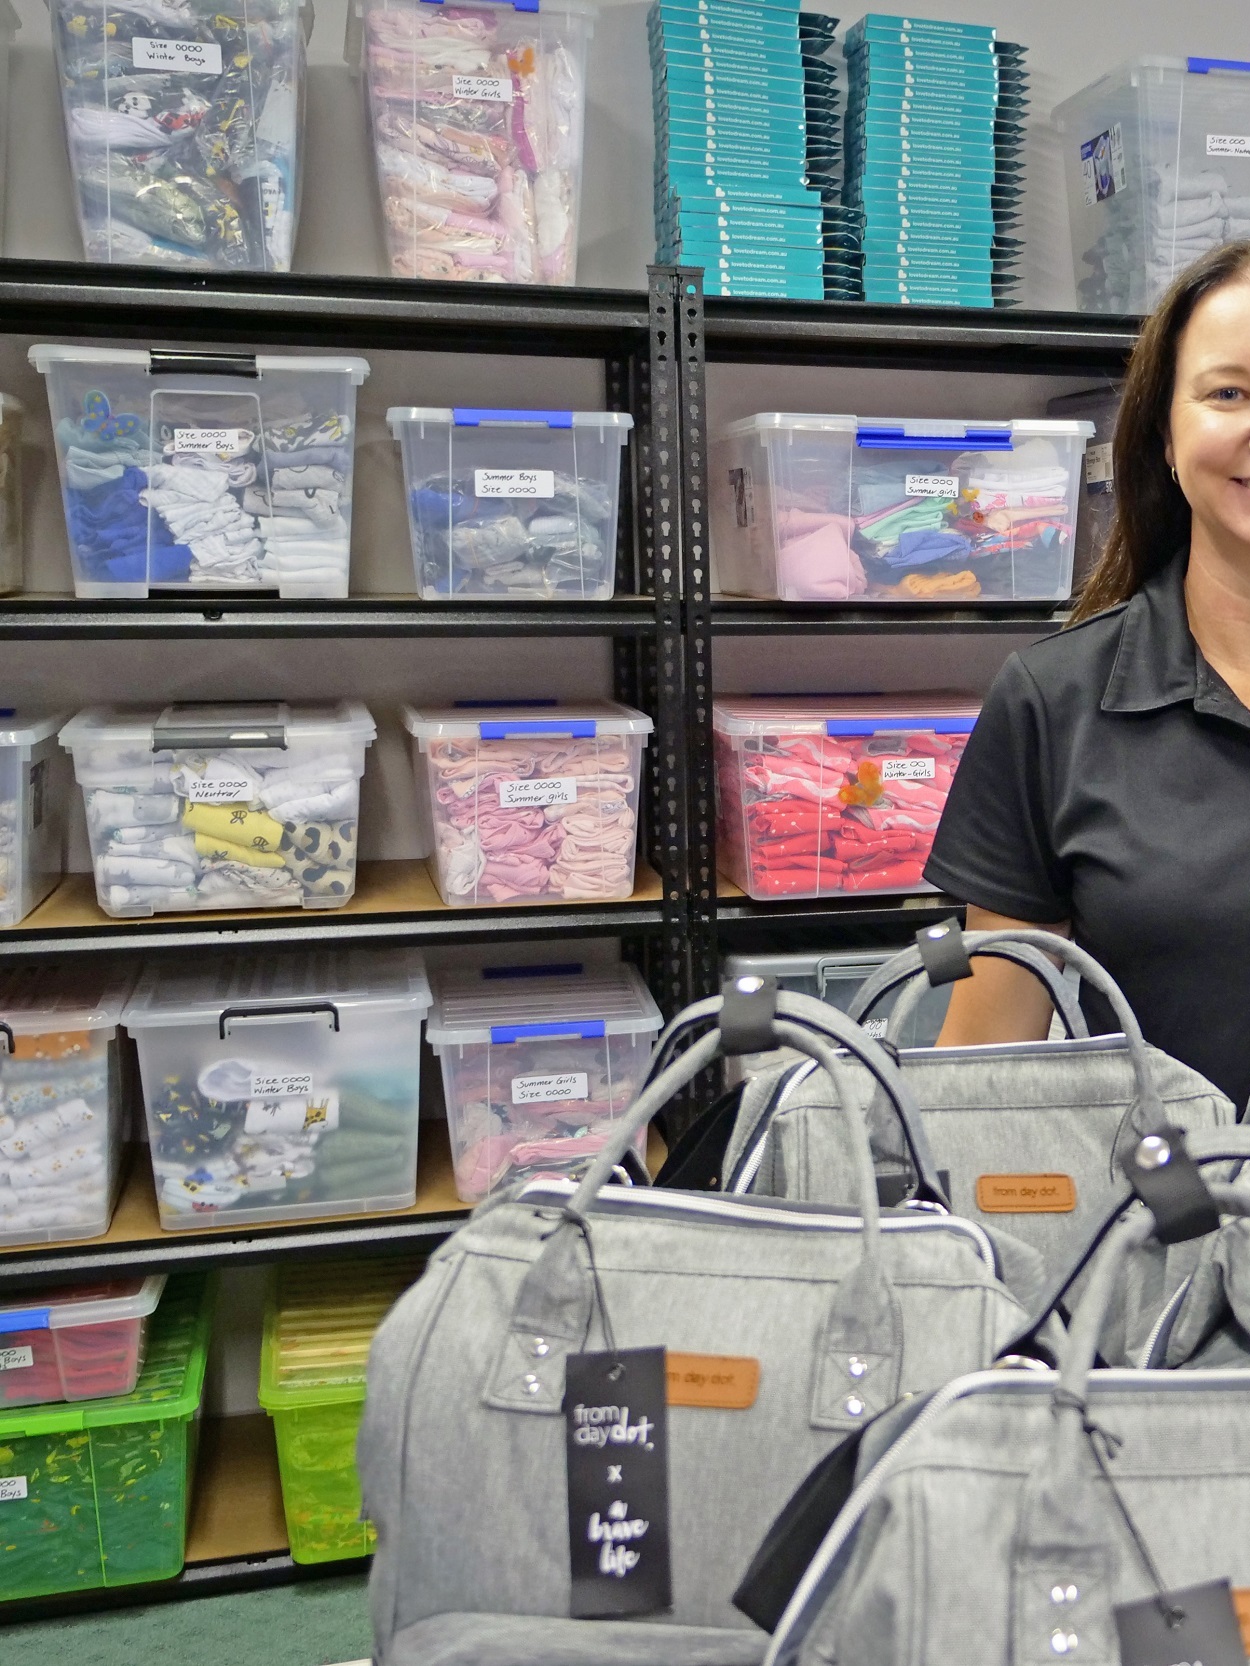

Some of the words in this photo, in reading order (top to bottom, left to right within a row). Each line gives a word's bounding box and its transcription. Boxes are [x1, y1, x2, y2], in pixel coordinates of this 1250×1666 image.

[711, 4, 762, 16] lovetodream.com.au
[711, 19, 763, 31] lovetodream.com.au
[914, 23, 963, 33] lovetodream.com.au
[712, 34, 764, 45] lovetodream.com.au
[912, 37, 960, 47] lovetodream.com.au
[149, 41, 168, 49] Size
[175, 43, 202, 53] 0000
[714, 47, 766, 58] lovetodream.com.au
[916, 51, 964, 60] lovetodream.com.au
[146, 51, 175, 61] Winter
[184, 54, 206, 67] Boys
[716, 61, 768, 73] lovetodream.com.au
[916, 64, 964, 74] lovetodream.com.au
[455, 77, 471, 85] Size
[476, 79, 500, 87] 0000
[716, 76, 768, 87] lovetodream.com.au
[917, 78, 965, 87] lovetodream.com.au
[455, 87, 480, 95] Winter
[481, 88, 501, 98] Girls
[717, 89, 768, 99] lovetodream.com.au
[916, 91, 964, 100] lovetodream.com.au
[717, 102, 769, 113] lovetodream.com.au
[913, 104, 961, 112] lovetodream.com.au
[718, 116, 770, 127] lovetodream.com.au
[912, 117, 960, 126] lovetodream.com.au
[718, 129, 770, 140] lovetodream.com.au
[911, 130, 959, 138] lovetodream.com.au
[719, 143, 770, 153] lovetodream.com.au
[913, 144, 961, 152] lovetodream.com.au
[717, 156, 769, 166] lovetodream.com.au
[913, 156, 961, 165] lovetodream.com.au
[717, 170, 769, 179] lovetodream.com.au
[913, 170, 961, 178] lovetodream.com.au
[909, 183, 957, 191] lovetodream.com.au
[728, 190, 782, 199] lovetodream.com.au
[909, 196, 957, 204] lovetodream.com.au
[733, 205, 786, 214] lovetodream.com.au
[911, 209, 959, 217] lovetodream.com.au
[730, 220, 784, 229] lovetodream.com.au
[732, 234, 785, 242] lovetodream.com.au
[734, 248, 787, 257] lovetodream.com.au
[732, 262, 785, 270] lovetodream.com.au
[733, 275, 786, 284] lovetodream.com.au
[177, 430, 198, 440] Size
[177, 441, 212, 450] Summer
[215, 440, 235, 450] Boys
[482, 472, 514, 481] Summer
[519, 472, 537, 482] Boys
[909, 476, 929, 484] Size
[931, 478, 954, 486] 000
[481, 484, 502, 494] Size
[508, 486, 537, 494] 0000
[907, 486, 936, 494] Summer
[938, 488, 957, 497] girls
[886, 760, 907, 769] Size
[191, 780, 215, 789] Size
[506, 782, 530, 792] Size
[533, 781, 562, 790] 0000
[195, 789, 241, 798] Neutral
[505, 793, 545, 803] Summer
[546, 792, 569, 804] girls
[255, 1076, 279, 1085] Size
[281, 1075, 311, 1084] 0000
[516, 1079, 554, 1089] Summer
[556, 1076, 577, 1085] Girls
[254, 1086, 283, 1094] Winter
[286, 1084, 309, 1093] Boys
[518, 1089, 542, 1099] Size
[545, 1088, 572, 1096] 0000
[993, 1187, 1017, 1197] from
[1019, 1187, 1038, 1199] day
[4, 1355, 26, 1364] Boys
[684, 1372, 709, 1386] day
[573, 1403, 620, 1425] from
[1, 1489, 21, 1498] Boys
[608, 1500, 628, 1520] a
[588, 1512, 650, 1542] brave
[599, 1540, 641, 1578] life
